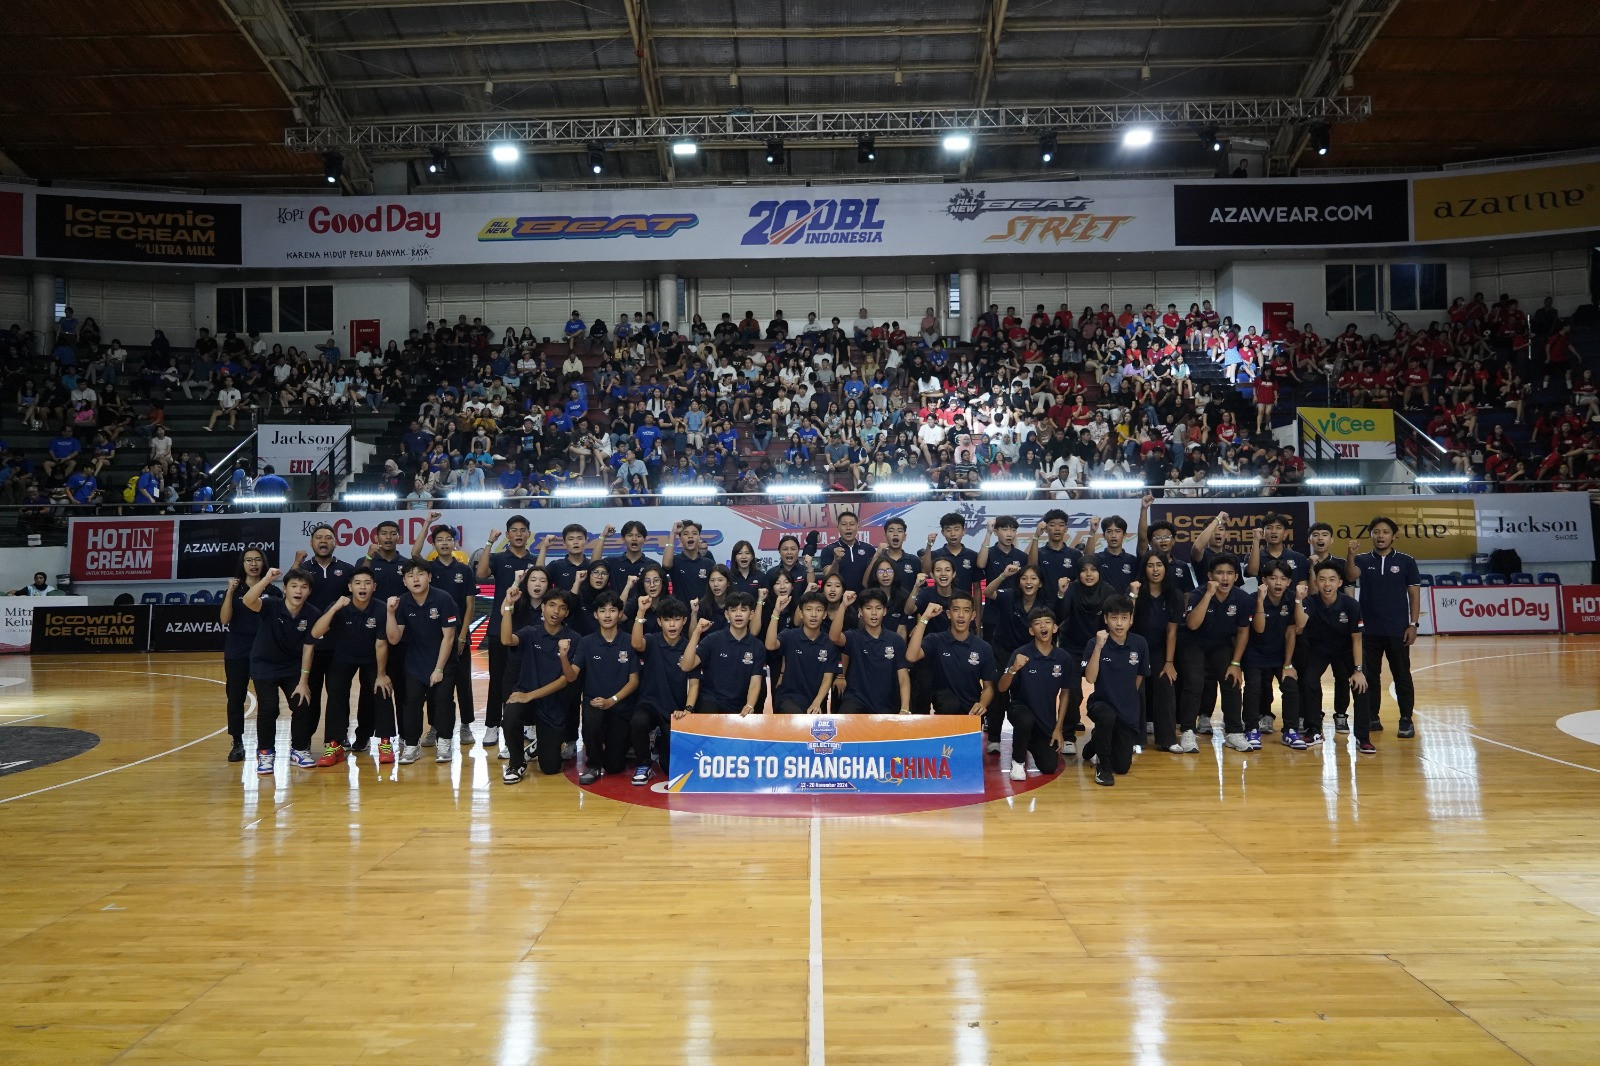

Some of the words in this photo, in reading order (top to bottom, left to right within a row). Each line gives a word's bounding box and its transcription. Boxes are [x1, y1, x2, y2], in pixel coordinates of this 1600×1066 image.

[951, 205, 977, 213] NEW
[957, 198, 978, 206] ALL
[807, 198, 885, 231] DBL
[1209, 204, 1373, 224] AZAWEAR.COM
[65, 223, 112, 239] ICE
[115, 226, 216, 243] CREAM
[983, 213, 1137, 246] STREET
[804, 231, 883, 245] INDONESIA
[145, 243, 183, 256] ULTRA
[186, 244, 216, 257] MILK
[286, 250, 321, 260] KARENA
[323, 250, 347, 259] HIDUP
[350, 249, 373, 259] PERLU
[271, 430, 335, 445] Jackson
[289, 459, 314, 474] EXIT
[1494, 515, 1578, 533] Jackson
[184, 541, 275, 553] AZAWEARCOM
[85, 550, 153, 570] CREAM
[5, 607, 34, 617] Mitr
[5, 617, 33, 627] Kelu
[45, 626, 72, 637] ICE
[74, 625, 135, 636] CREAM
[91, 636, 113, 645] ULTRA
[114, 636, 134, 645] MILK
[698, 755, 750, 779] GOES
[754, 755, 779, 779] TO
[783, 755, 885, 779] SHANGHAI
[890, 756, 952, 780] CHINA
